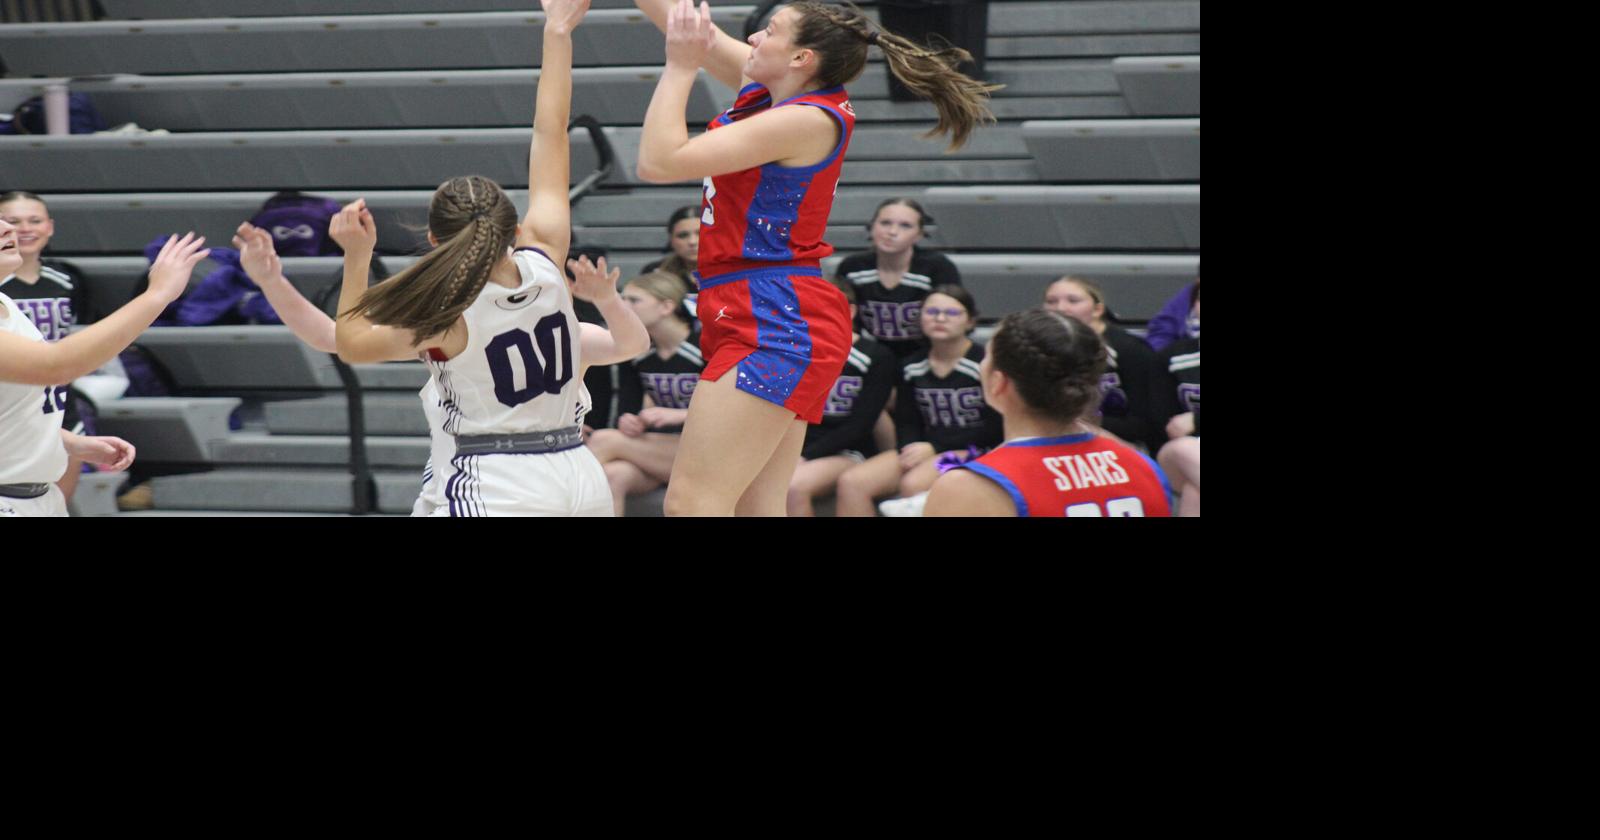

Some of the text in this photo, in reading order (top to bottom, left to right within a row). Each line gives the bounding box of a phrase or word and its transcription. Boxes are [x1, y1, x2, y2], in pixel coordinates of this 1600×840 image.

[14, 298, 74, 341] HS
[485, 310, 573, 408] 00
[1042, 450, 1130, 491] STARS
